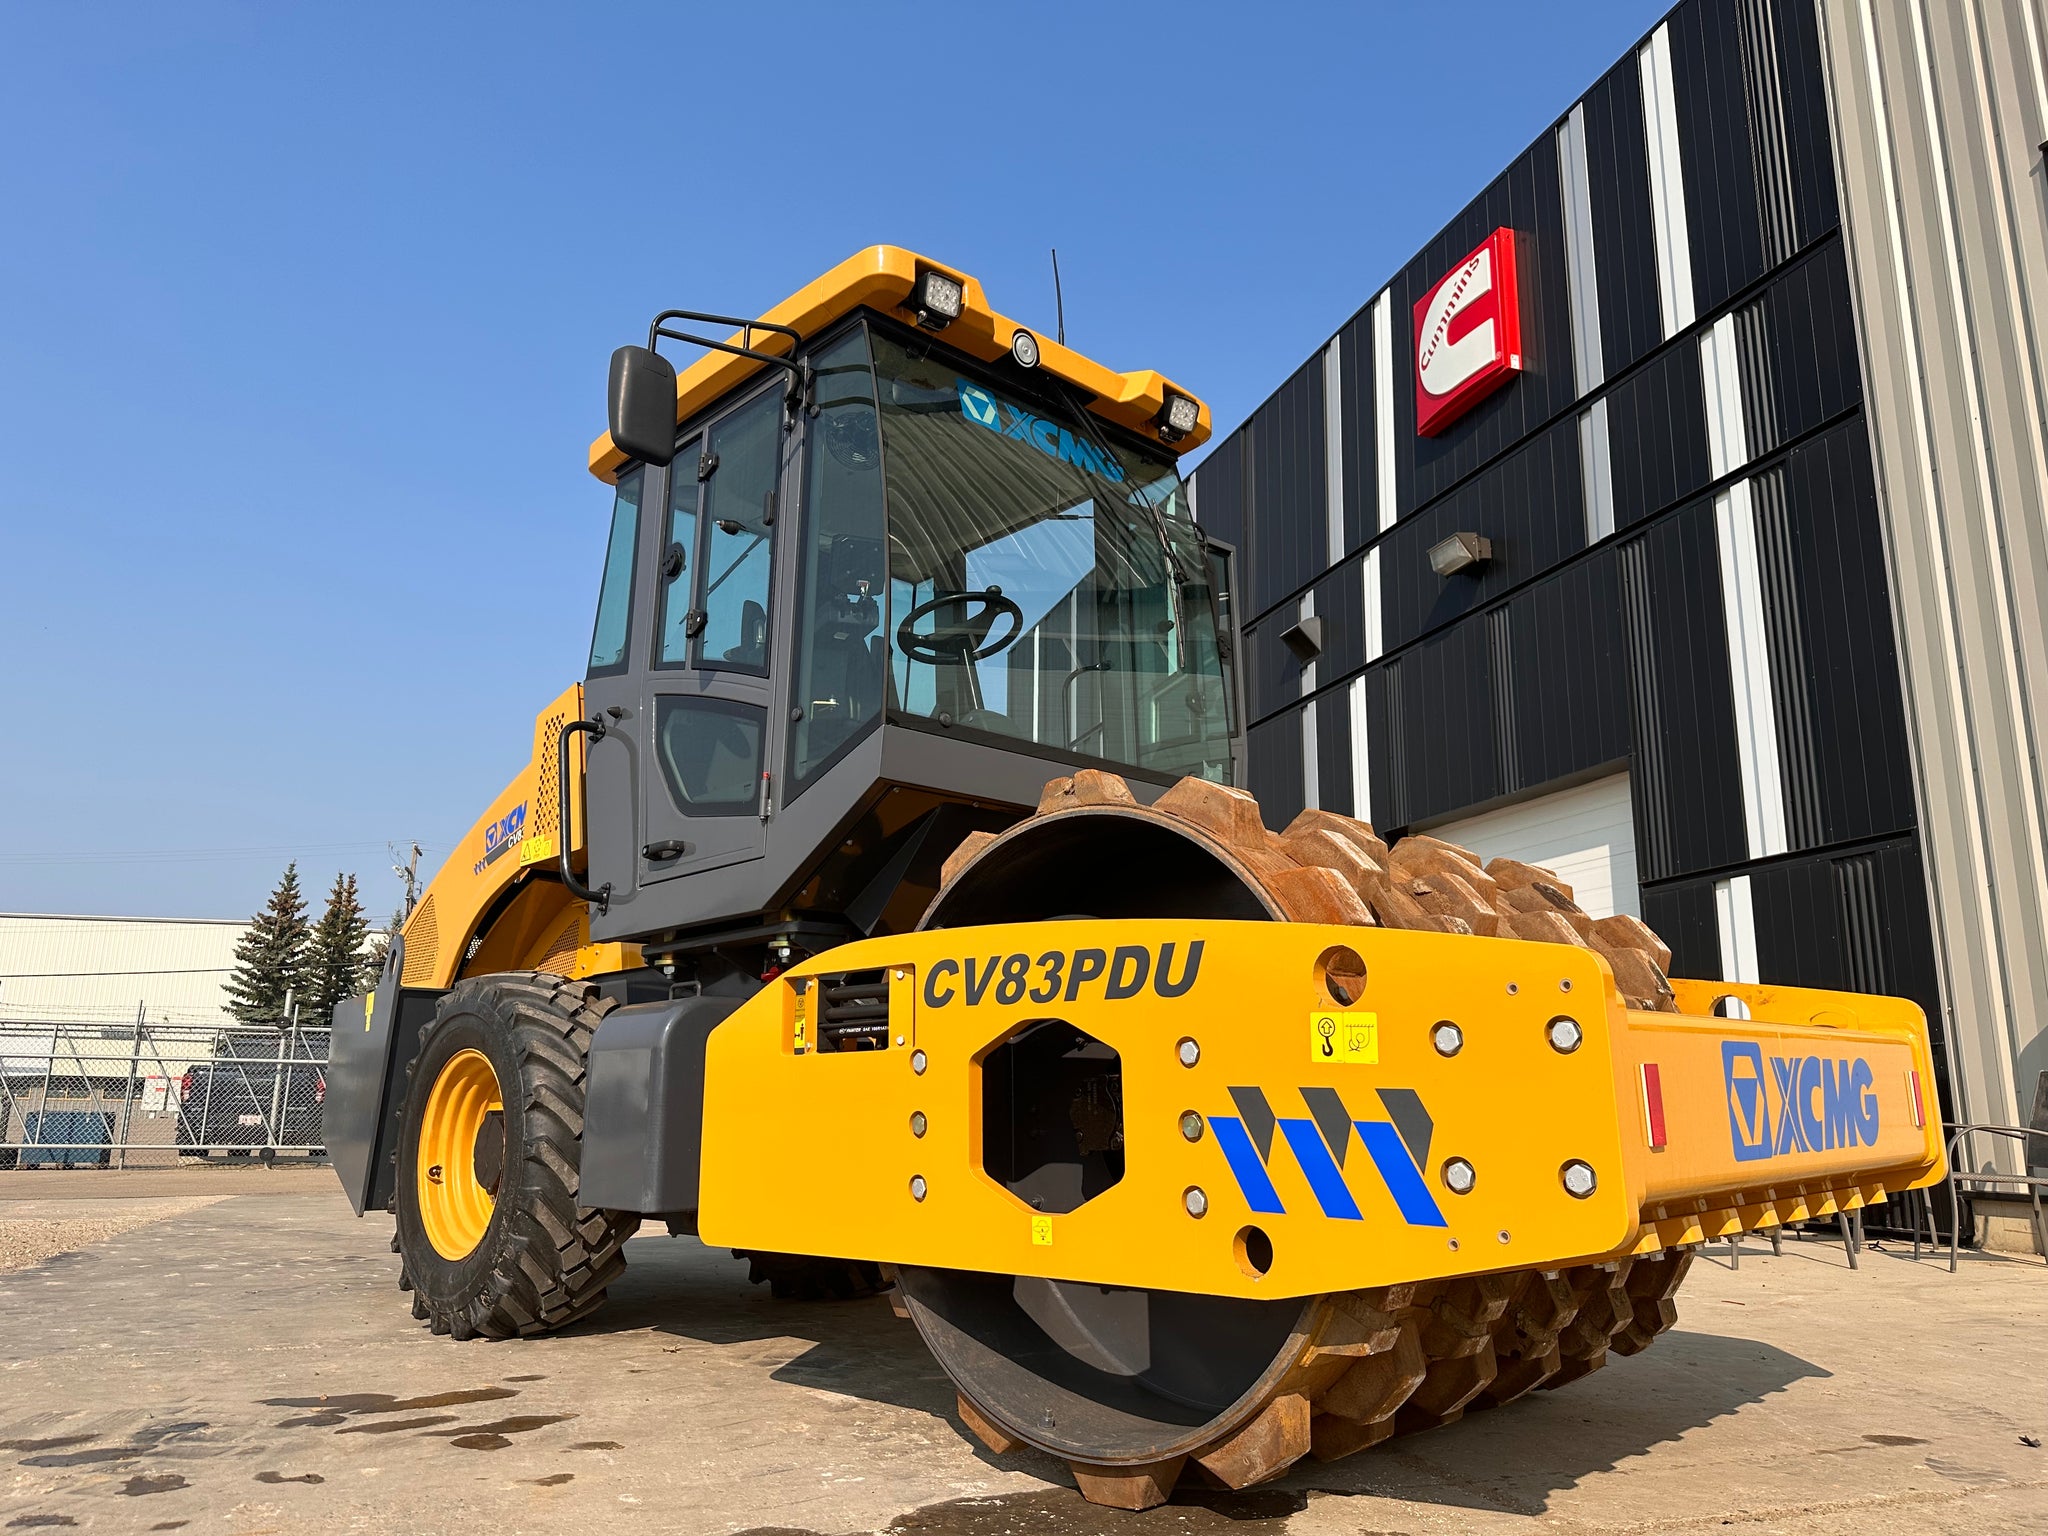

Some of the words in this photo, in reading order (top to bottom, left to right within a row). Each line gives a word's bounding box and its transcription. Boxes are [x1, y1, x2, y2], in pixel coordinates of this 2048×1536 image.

[1420, 255, 1480, 373] Cummins
[1002, 402, 1125, 483] XCMG
[923, 940, 1206, 1009] CV83PDU
[1769, 1055, 1880, 1156] XCMG
